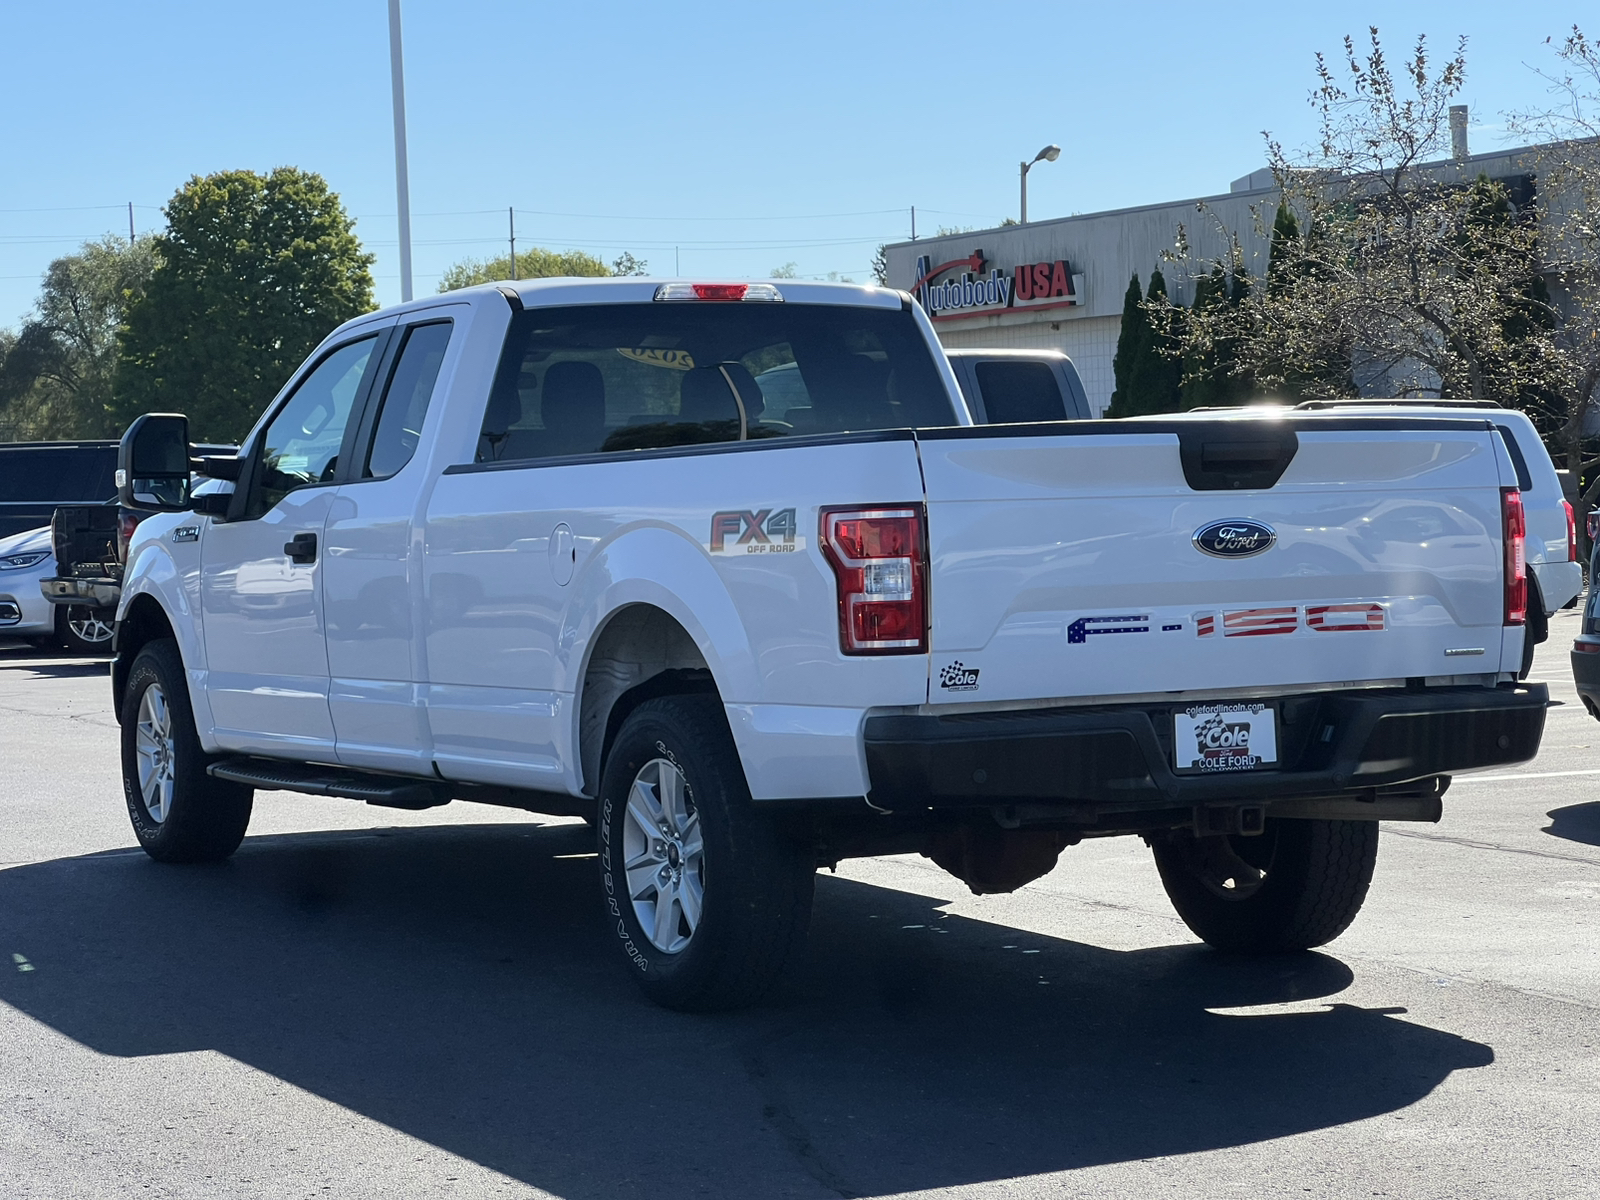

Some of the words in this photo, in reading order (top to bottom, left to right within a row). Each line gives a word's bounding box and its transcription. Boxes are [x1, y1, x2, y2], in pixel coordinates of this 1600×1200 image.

[913, 255, 1012, 318] Autobody
[1015, 260, 1073, 300] USA
[709, 507, 797, 552] FX4
[1214, 526, 1259, 550] Ford
[747, 545, 766, 554] OFF
[769, 544, 796, 553] ROAD
[945, 672, 976, 686] Cole
[1185, 702, 1265, 715] colefordlincoln.com
[1205, 726, 1249, 748] Cole
[1198, 756, 1226, 769] COLE
[1228, 755, 1256, 767] FORD
[1201, 765, 1255, 773] COLDWATER
[600, 797, 649, 973] WRANGLER
